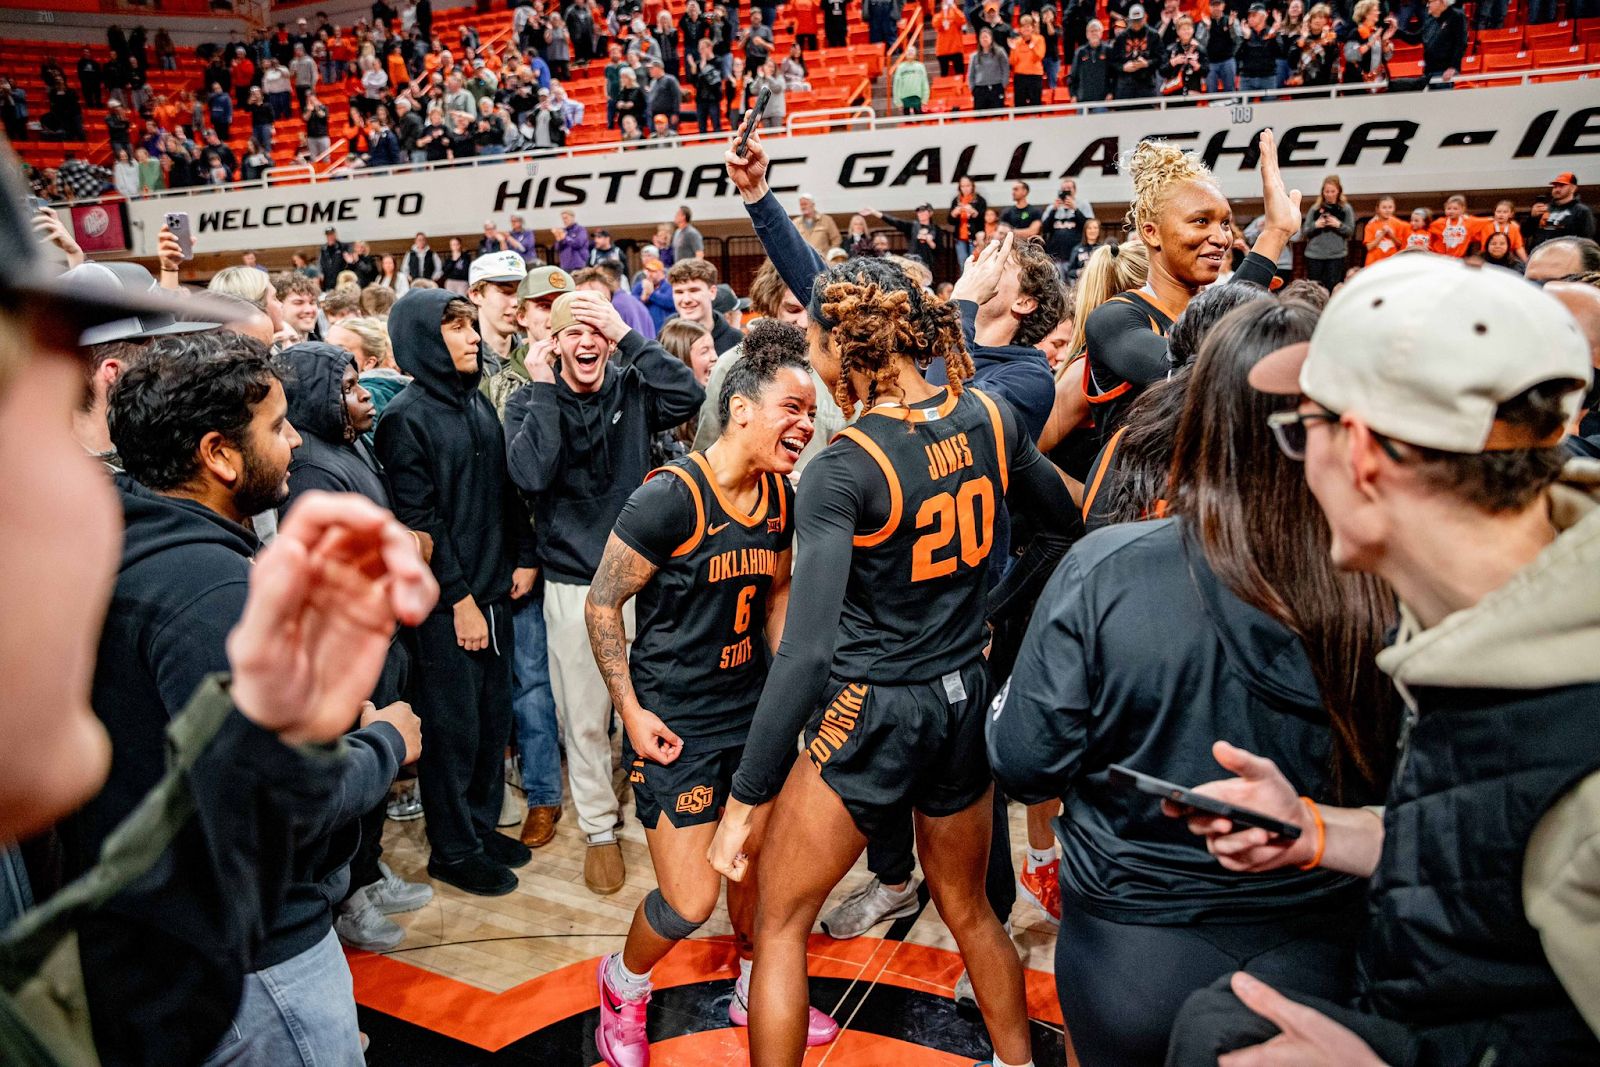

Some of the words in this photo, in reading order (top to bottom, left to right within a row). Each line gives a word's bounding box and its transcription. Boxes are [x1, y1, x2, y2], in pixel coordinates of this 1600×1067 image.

[1231, 105, 1253, 124] 108
[198, 197, 361, 233] WELCOME
[373, 192, 424, 218] TO
[493, 156, 808, 213] HISTORC
[924, 432, 974, 481] JONES
[910, 475, 996, 583] 20
[733, 585, 757, 635] 6
[676, 785, 714, 814] OSU
